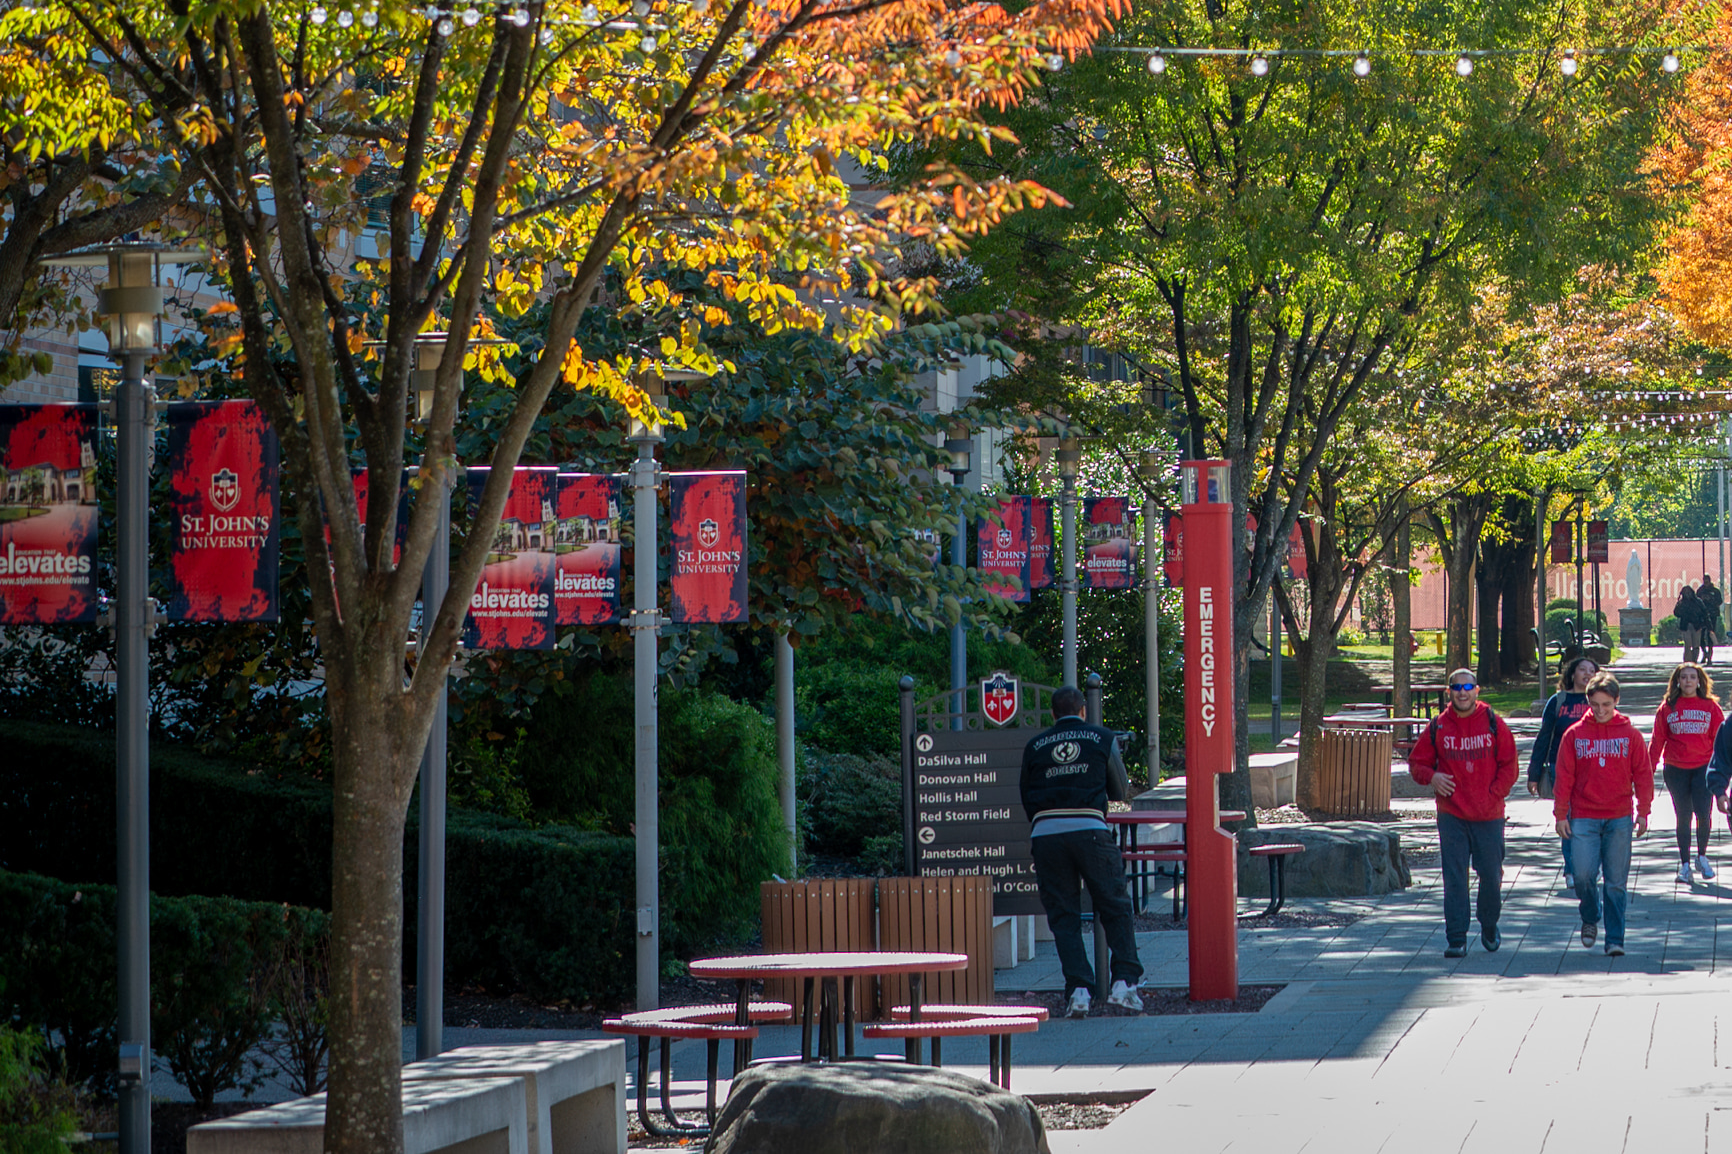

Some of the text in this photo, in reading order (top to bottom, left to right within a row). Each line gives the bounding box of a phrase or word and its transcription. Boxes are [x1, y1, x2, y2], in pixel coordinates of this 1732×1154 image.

[182, 514, 269, 536] ST. JOHN'S
[182, 535, 268, 549] UNIVERSITY
[678, 550, 740, 565] ST. JOHN'S
[994, 549, 1027, 561] JOHN'S
[1087, 554, 1127, 568] elevates
[678, 564, 740, 574] UNIVERSITY
[471, 581, 549, 608] elevates
[1199, 587, 1216, 737] EMERGENCY
[1443, 733, 1492, 751] ST. JOHN'S
[918, 753, 987, 766] DaSilva Hall
[919, 771, 997, 785] Donovan Hall
[919, 790, 978, 803] Hollis Hall
[920, 808, 1010, 822] Red Storm Field
[921, 846, 1005, 859] Janetschek Hall
[921, 866, 954, 877] Helen
[957, 865, 980, 876] and
[983, 863, 1014, 877] Hugh
[1003, 882, 1039, 892] O'Con
